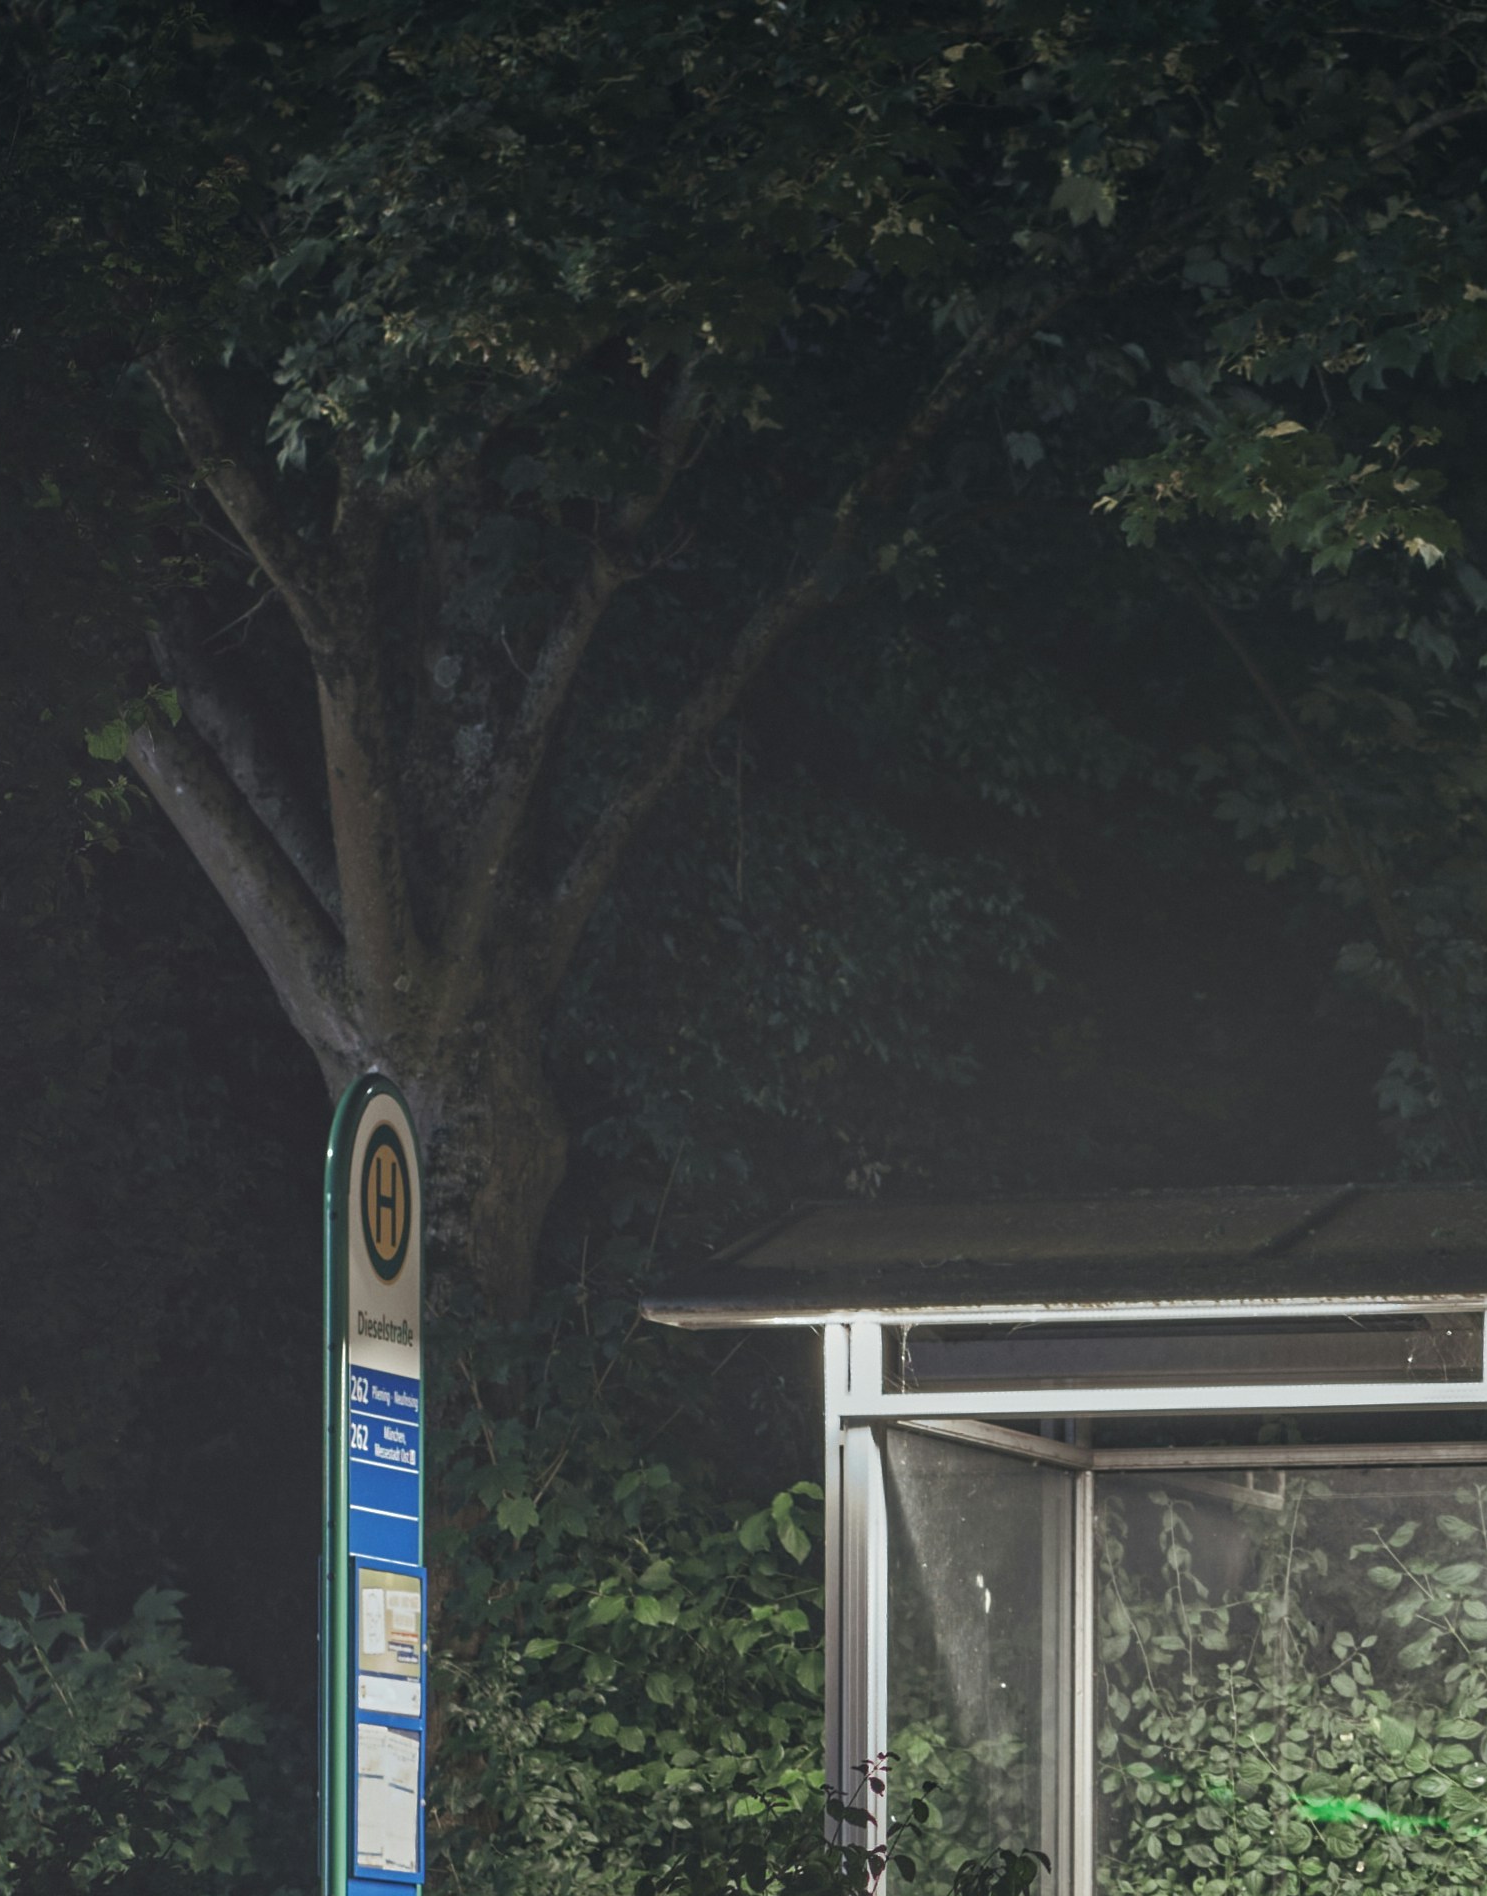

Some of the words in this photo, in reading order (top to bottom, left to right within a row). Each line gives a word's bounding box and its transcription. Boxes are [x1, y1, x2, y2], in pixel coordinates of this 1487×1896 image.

[375, 1157, 397, 1248] H
[357, 1310, 414, 1348] Dieselstraße
[351, 1375, 369, 1405] 262
[350, 1422, 369, 1452] 262
